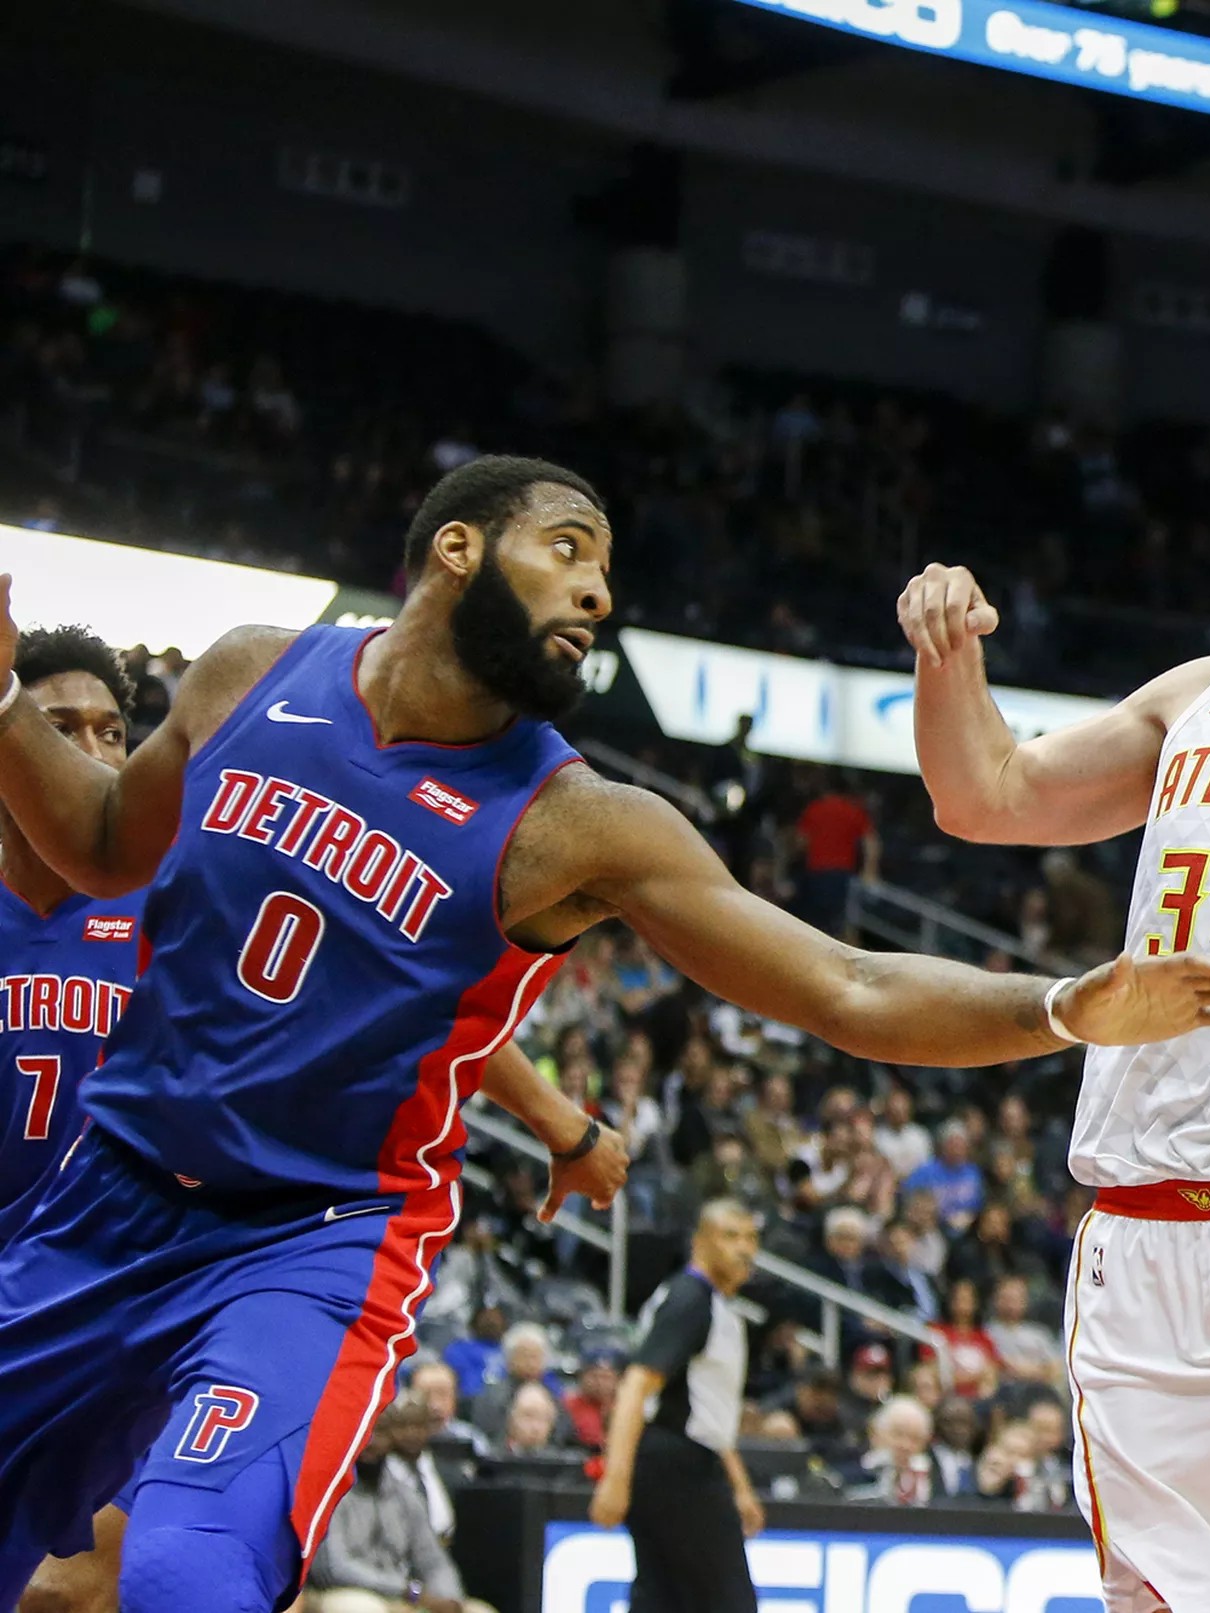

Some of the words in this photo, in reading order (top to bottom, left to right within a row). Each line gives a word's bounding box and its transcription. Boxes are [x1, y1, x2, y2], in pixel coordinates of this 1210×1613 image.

[420, 781, 474, 813] Flagstar
[201, 769, 453, 943] DETROIT
[87, 918, 133, 931] Flagstar
[236, 891, 326, 1005] 0
[0, 974, 134, 1038] TROIT
[15, 1055, 62, 1140] 7
